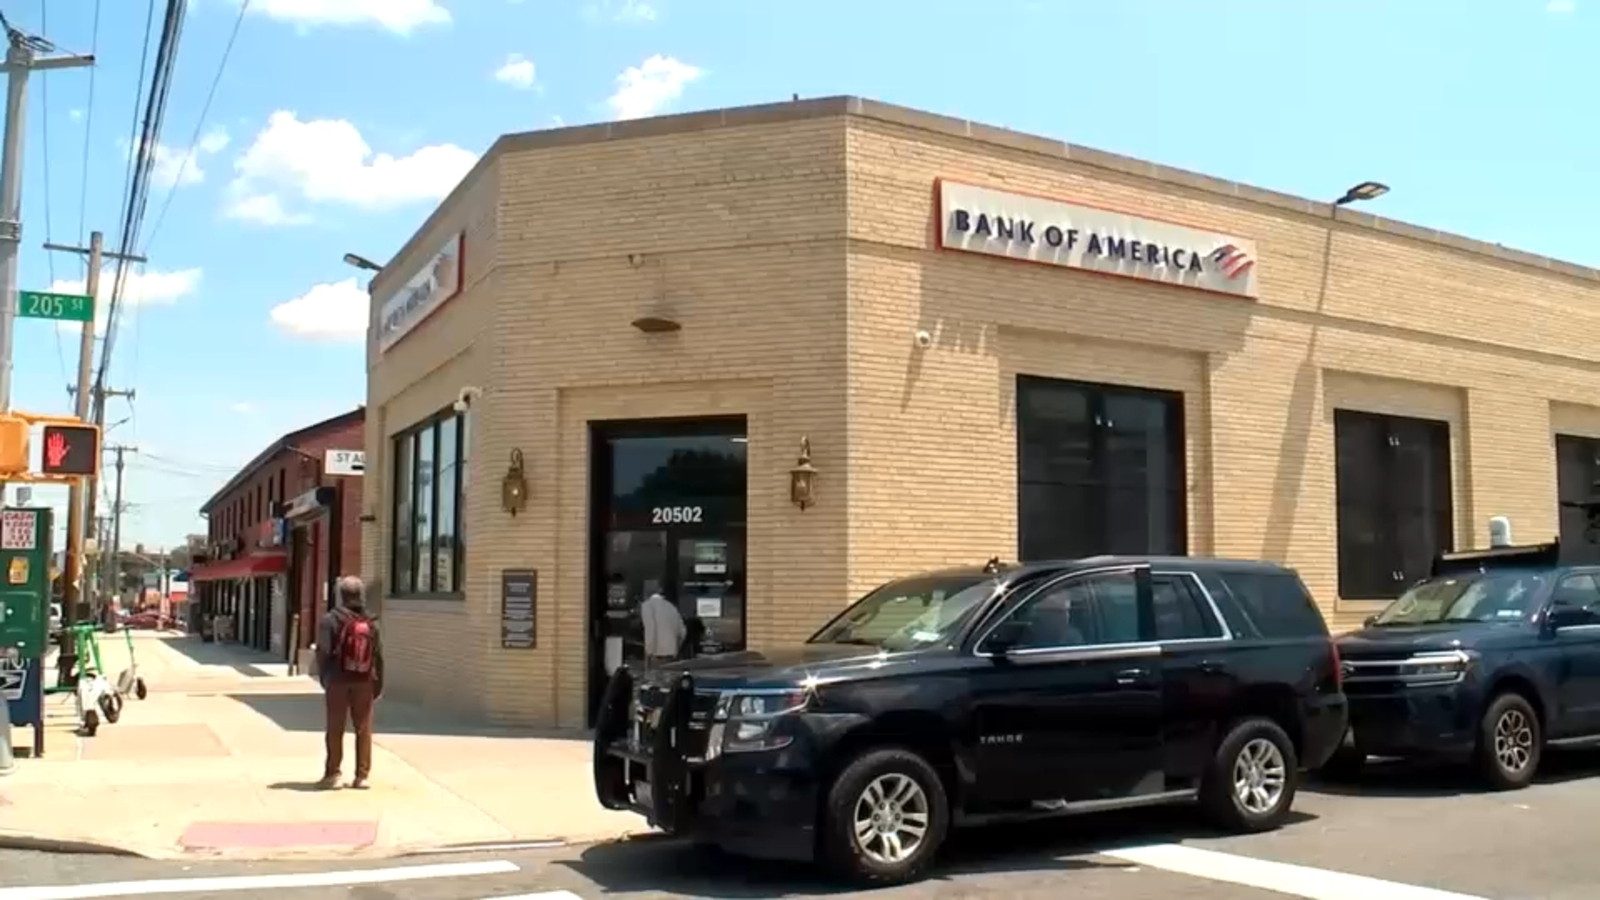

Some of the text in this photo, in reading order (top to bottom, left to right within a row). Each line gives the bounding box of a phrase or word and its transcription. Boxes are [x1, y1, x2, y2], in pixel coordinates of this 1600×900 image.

[954, 208, 1204, 273] BANK OF AMERICA
[28, 295, 64, 316] 205
[336, 452, 365, 462] STA
[652, 506, 703, 523] 20502
[980, 734, 1024, 744] TAHOE
